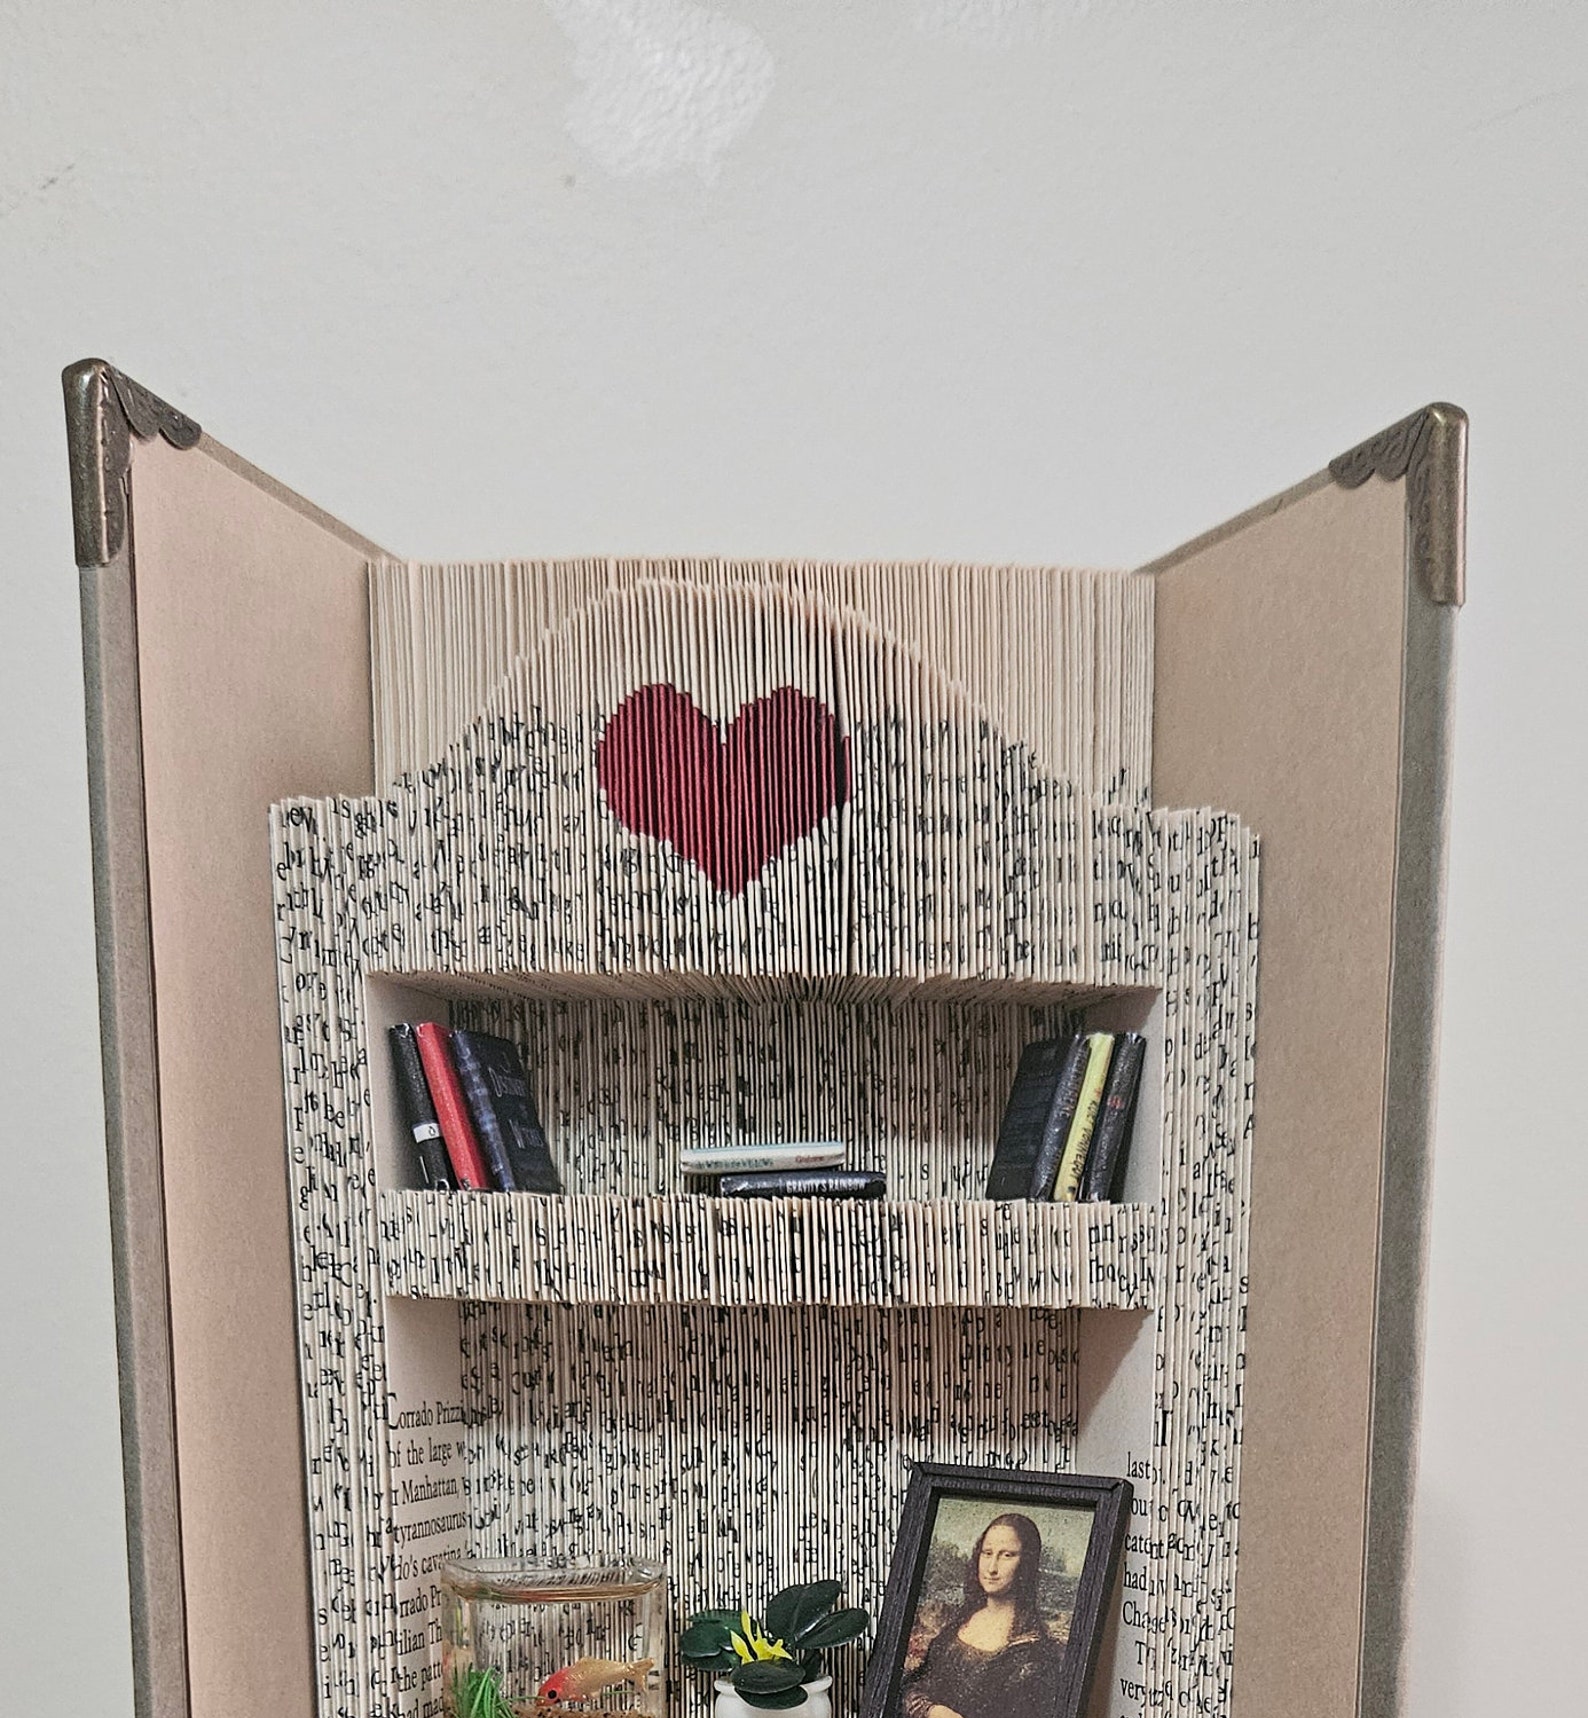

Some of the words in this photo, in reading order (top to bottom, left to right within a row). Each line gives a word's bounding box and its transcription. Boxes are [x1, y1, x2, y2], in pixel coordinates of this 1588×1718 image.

[786, 1179, 827, 1194] GRAVITY'S
[828, 1178, 866, 1193] RAINBOW
[407, 1439, 424, 1466] the
[428, 1437, 452, 1466] large
[402, 1475, 460, 1505] Manhattan,
[394, 1511, 467, 1549] tyrannosaurus
[1123, 1561, 1147, 1591] had
